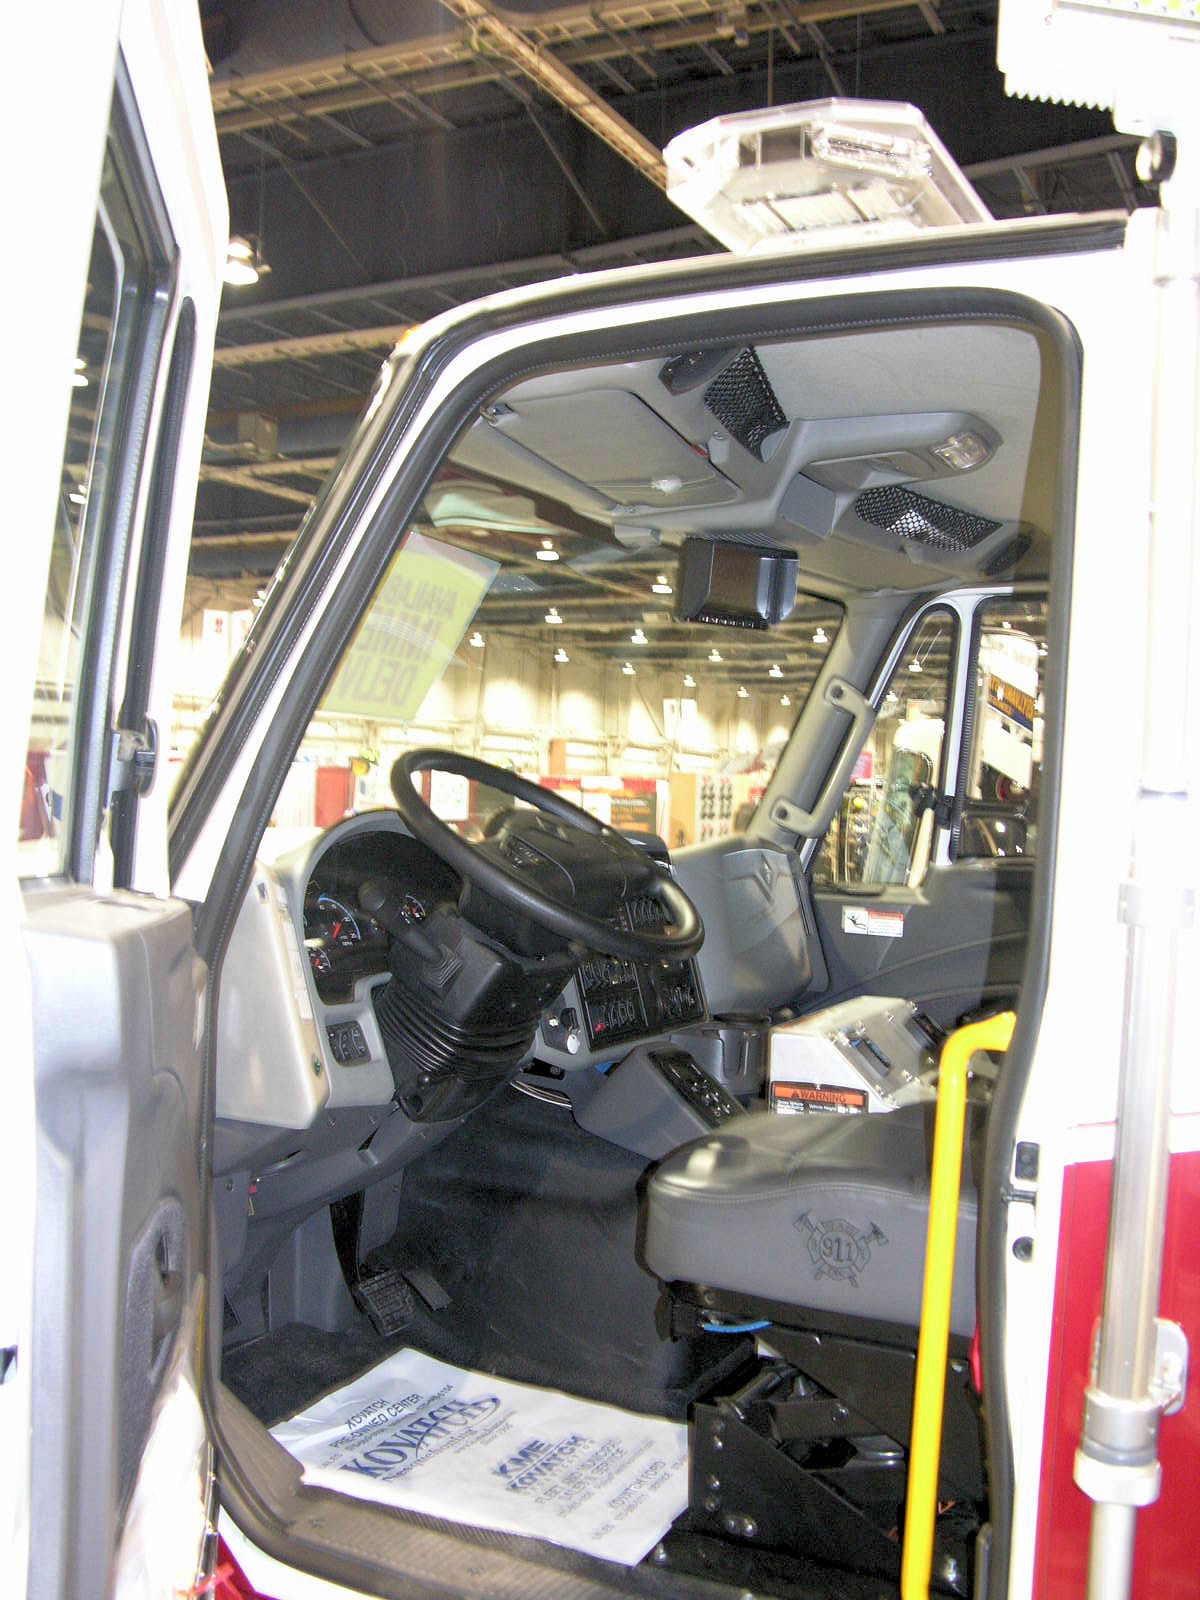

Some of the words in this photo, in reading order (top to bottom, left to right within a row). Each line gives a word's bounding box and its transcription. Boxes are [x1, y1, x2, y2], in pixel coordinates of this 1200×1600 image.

[800, 1089, 847, 1104] WARNING
[822, 1236, 853, 1262] 911
[386, 1392, 424, 1418] CENTER
[339, 1399, 492, 1481] KOVATCH
[491, 1439, 552, 1478] KME
[505, 1433, 588, 1493] KOVATCH
